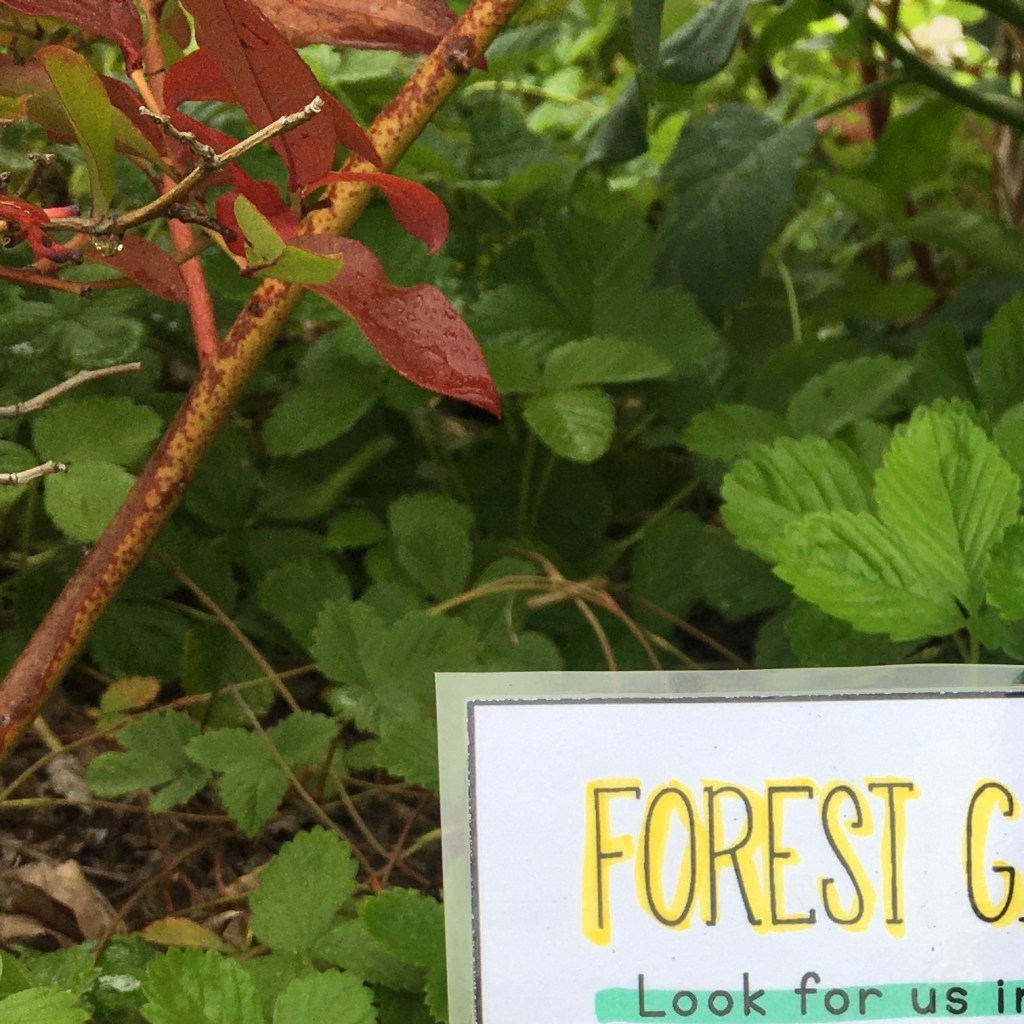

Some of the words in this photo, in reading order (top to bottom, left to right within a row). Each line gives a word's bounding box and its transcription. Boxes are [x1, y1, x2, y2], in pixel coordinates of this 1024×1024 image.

[592, 781, 916, 930] FOREST
[636, 972, 767, 1018] Look
[793, 970, 883, 1016] for
[909, 986, 969, 1016] us
